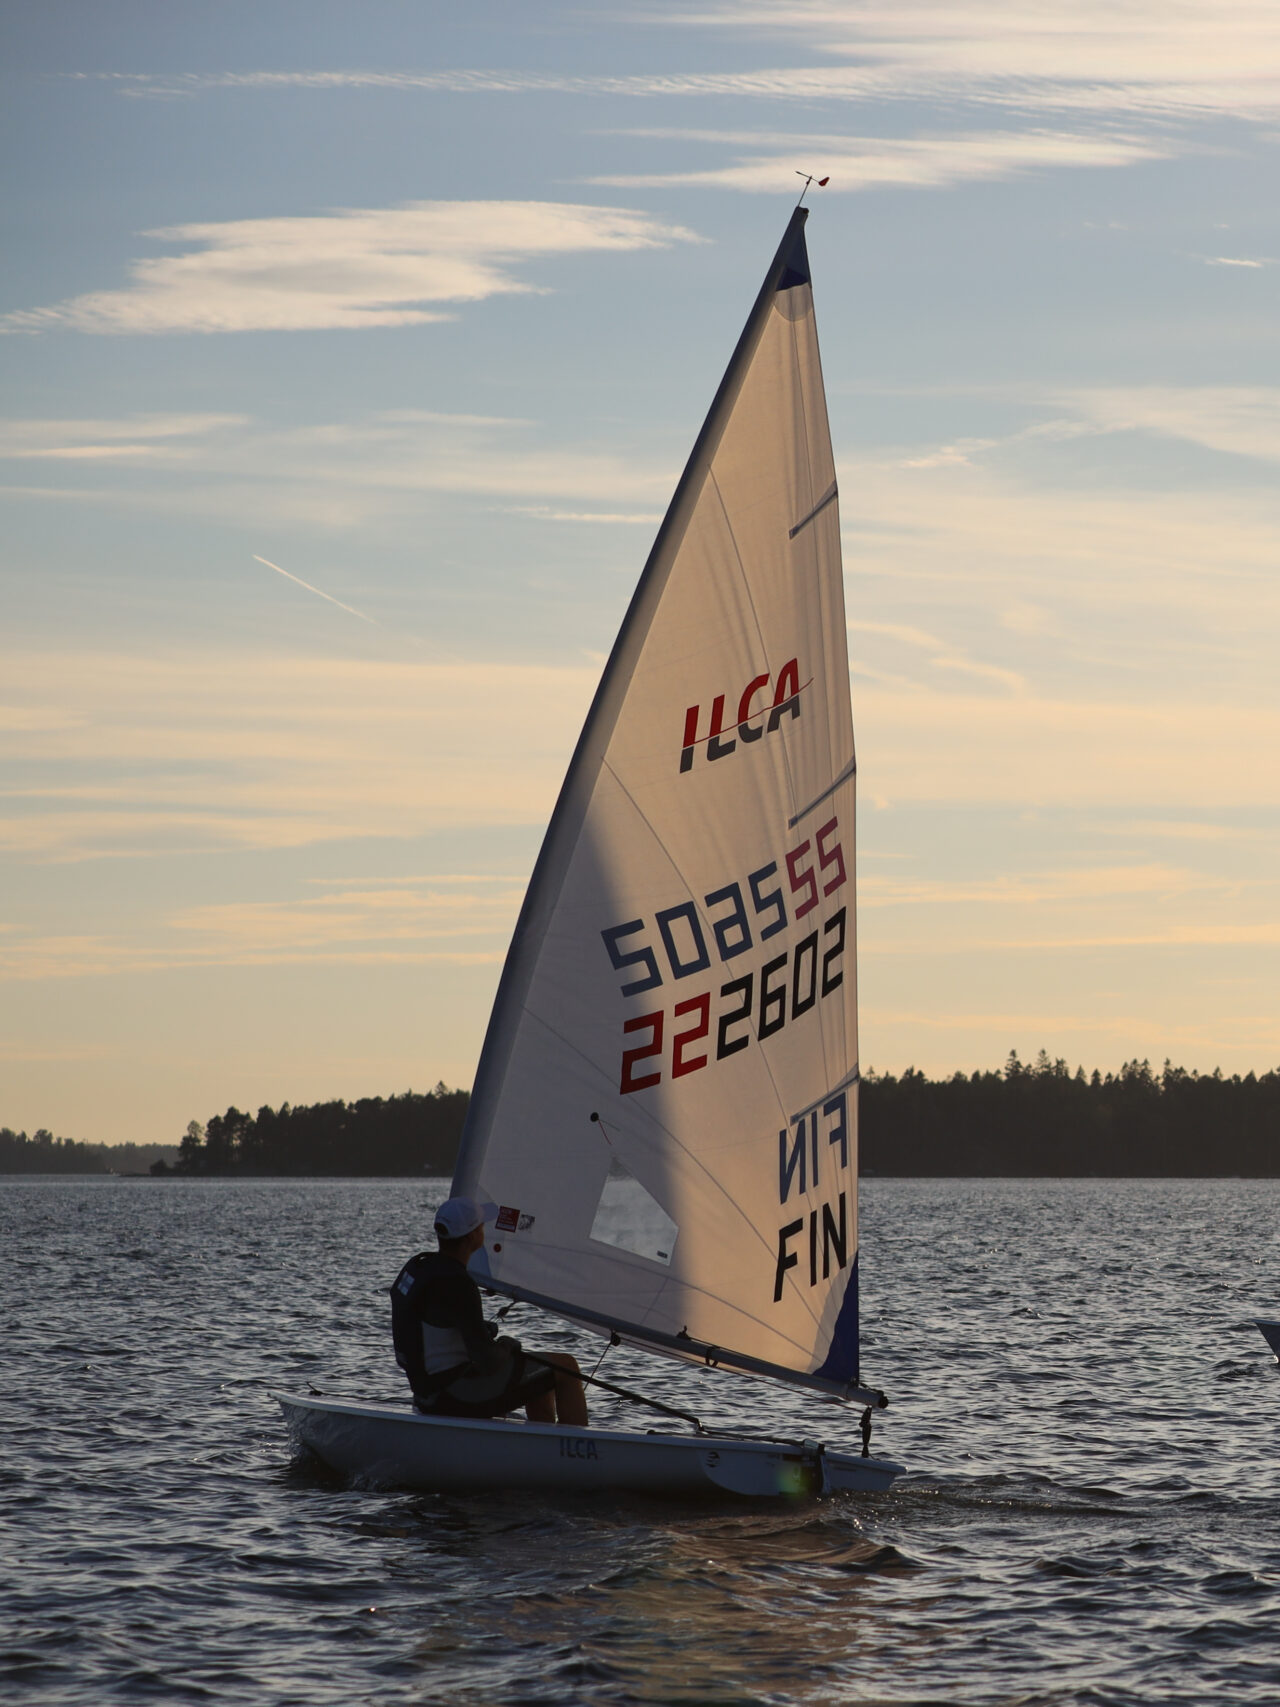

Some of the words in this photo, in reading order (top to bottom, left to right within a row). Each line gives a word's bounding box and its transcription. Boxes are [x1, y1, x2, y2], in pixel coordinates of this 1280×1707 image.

[680, 658, 801, 774] ILCA
[619, 906, 847, 1096] 222602
[773, 1191, 847, 1304] FIN
[559, 1438, 599, 1460] ILCA
